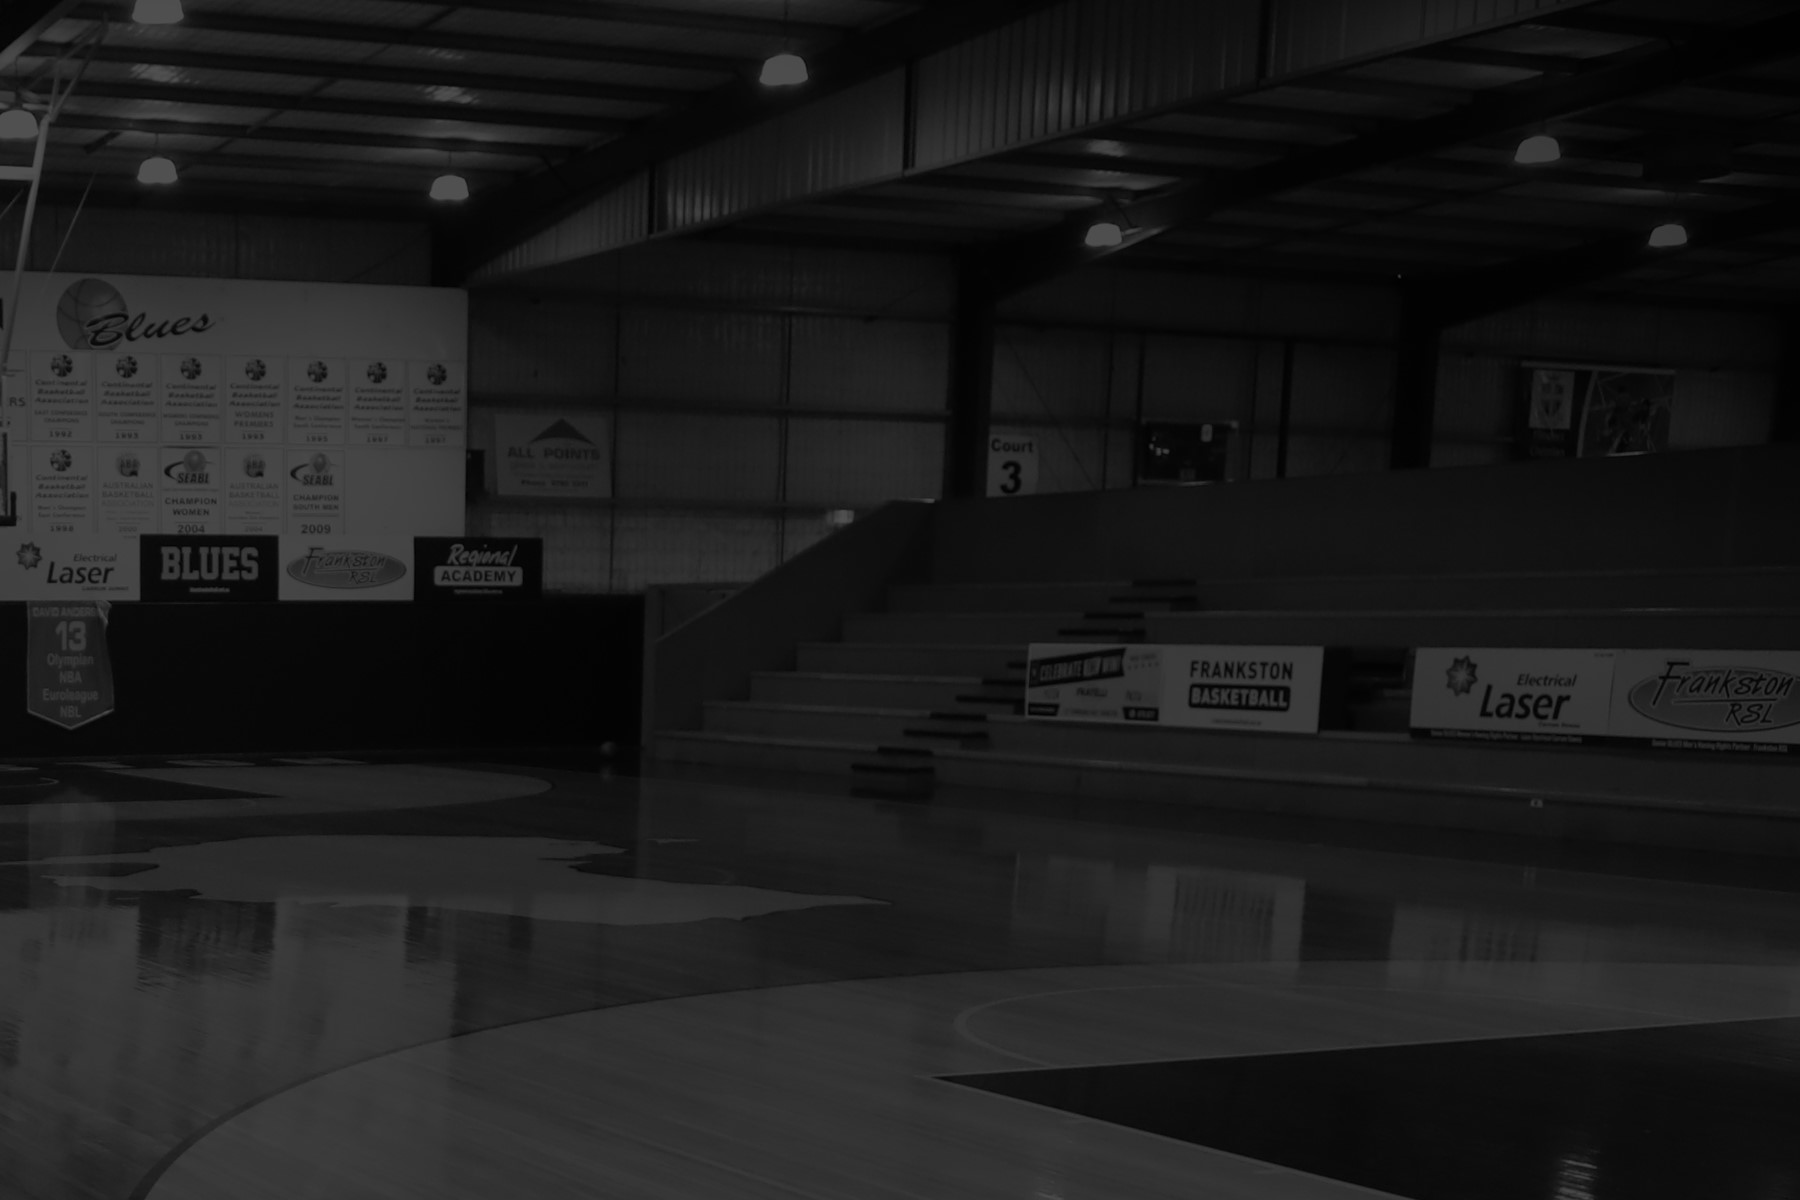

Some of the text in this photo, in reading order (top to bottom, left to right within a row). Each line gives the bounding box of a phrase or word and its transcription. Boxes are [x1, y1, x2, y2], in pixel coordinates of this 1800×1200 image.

[86, 311, 216, 347] Blues
[49, 430, 73, 438] 1992
[991, 437, 1034, 453] Court
[507, 446, 600, 460] ALL POINTS
[177, 472, 210, 484] SEABL
[302, 474, 333, 486] SEABL
[1000, 460, 1022, 494] 3
[102, 481, 154, 489] AUSTRALIAN
[229, 482, 279, 490] AUSTRALIAN
[102, 490, 155, 498] BASKETBALL
[164, 497, 218, 505] CHAMPION
[228, 491, 280, 499] BASKETBALL
[292, 494, 339, 502] CHAMPION
[172, 508, 210, 516] WOMEN
[177, 524, 206, 534] 2004
[300, 524, 331, 534] 2009
[72, 552, 117, 562] Electrical
[303, 546, 388, 574] Frankston
[446, 543, 519, 567] Regional
[160, 546, 260, 581] BLUES
[46, 561, 115, 584] Laser
[348, 569, 378, 585] RSL
[439, 569, 518, 582] ACADEMY
[32, 606, 97, 618] DAVID ANDERS
[55, 620, 87, 652] 13
[47, 652, 94, 668] Olympian
[1190, 660, 1293, 680] FRANKSTON
[59, 671, 83, 684] NBA
[1517, 673, 1578, 689] Electrical
[1652, 660, 1794, 707] Frankston
[42, 688, 99, 703] Euroleague
[1191, 686, 1288, 709] BASKETBALL
[1479, 684, 1572, 721] Laser
[59, 705, 82, 719] NBL
[1724, 702, 1774, 727] RSL
